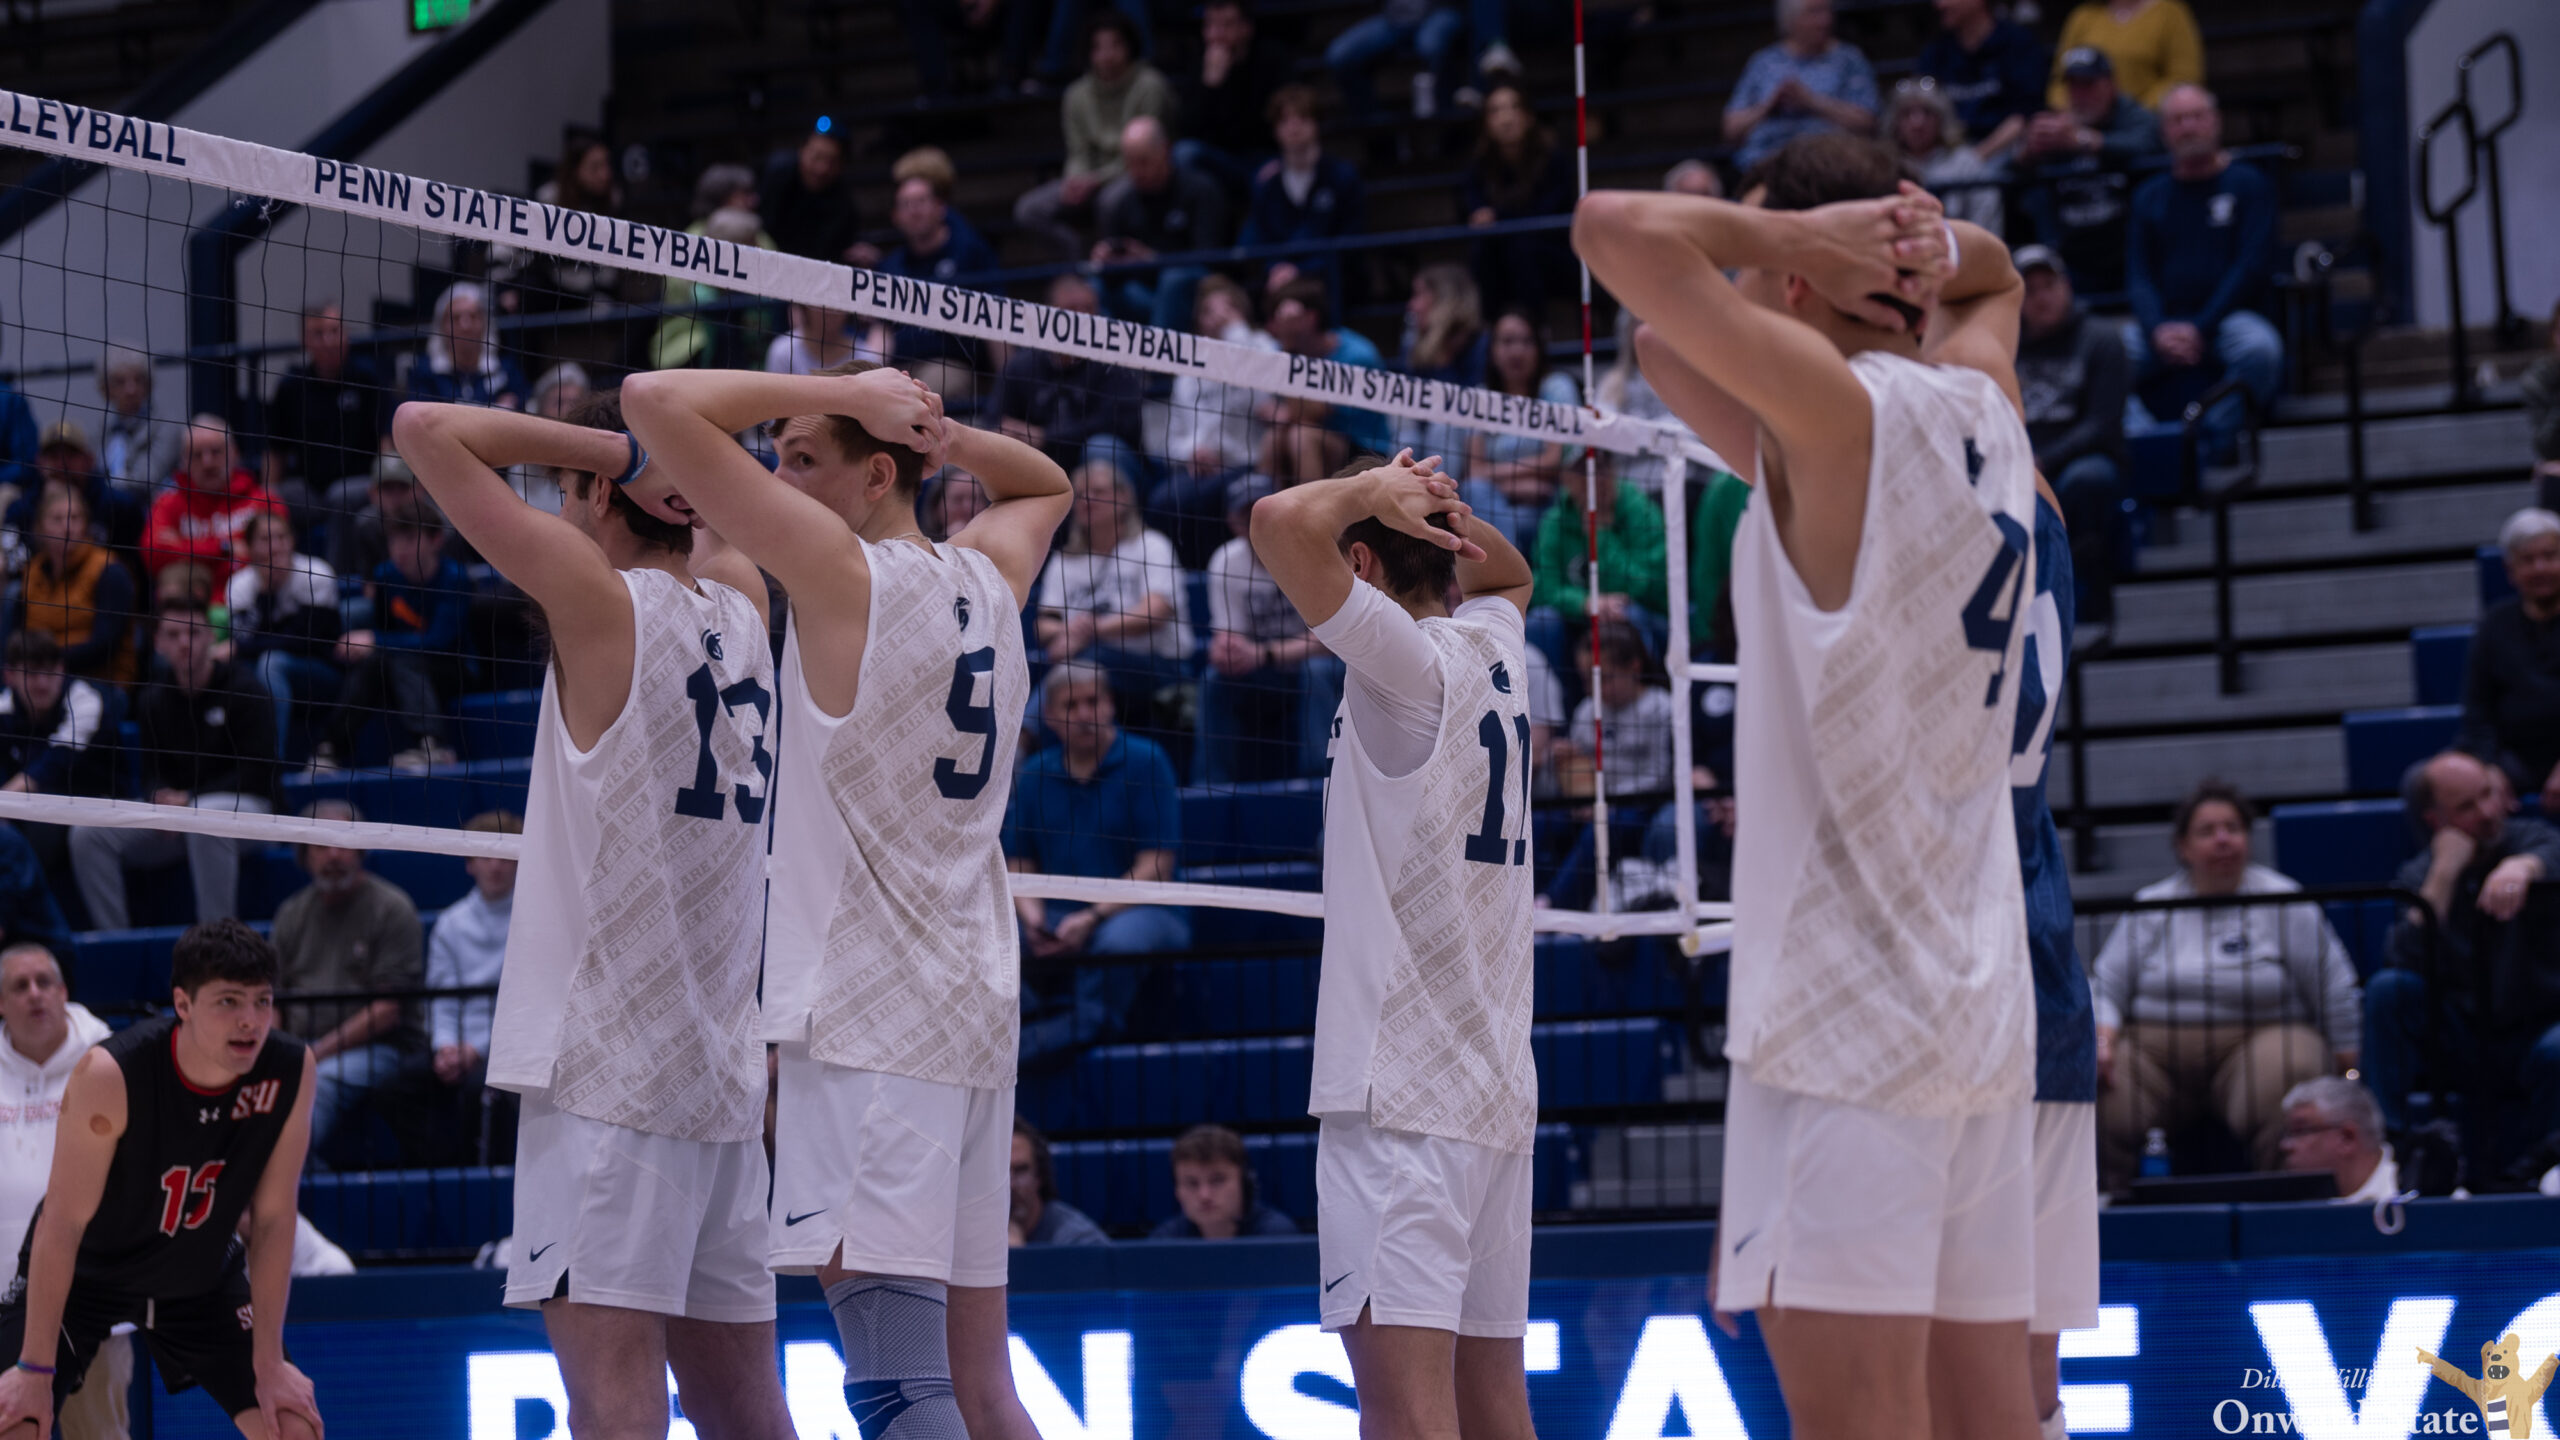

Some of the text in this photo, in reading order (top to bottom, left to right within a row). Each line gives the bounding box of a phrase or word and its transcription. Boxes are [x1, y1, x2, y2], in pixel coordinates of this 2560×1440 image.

[0, 92, 186, 166] LEYBALL
[314, 157, 748, 280] PENN STATE VOLLEYBALL
[851, 267, 1206, 368] PENN STATE VOLLEYBALL
[1288, 354, 1583, 435] PENN STATE VOLLEYBALL
[674, 661, 773, 825] 13
[932, 645, 997, 800] 9
